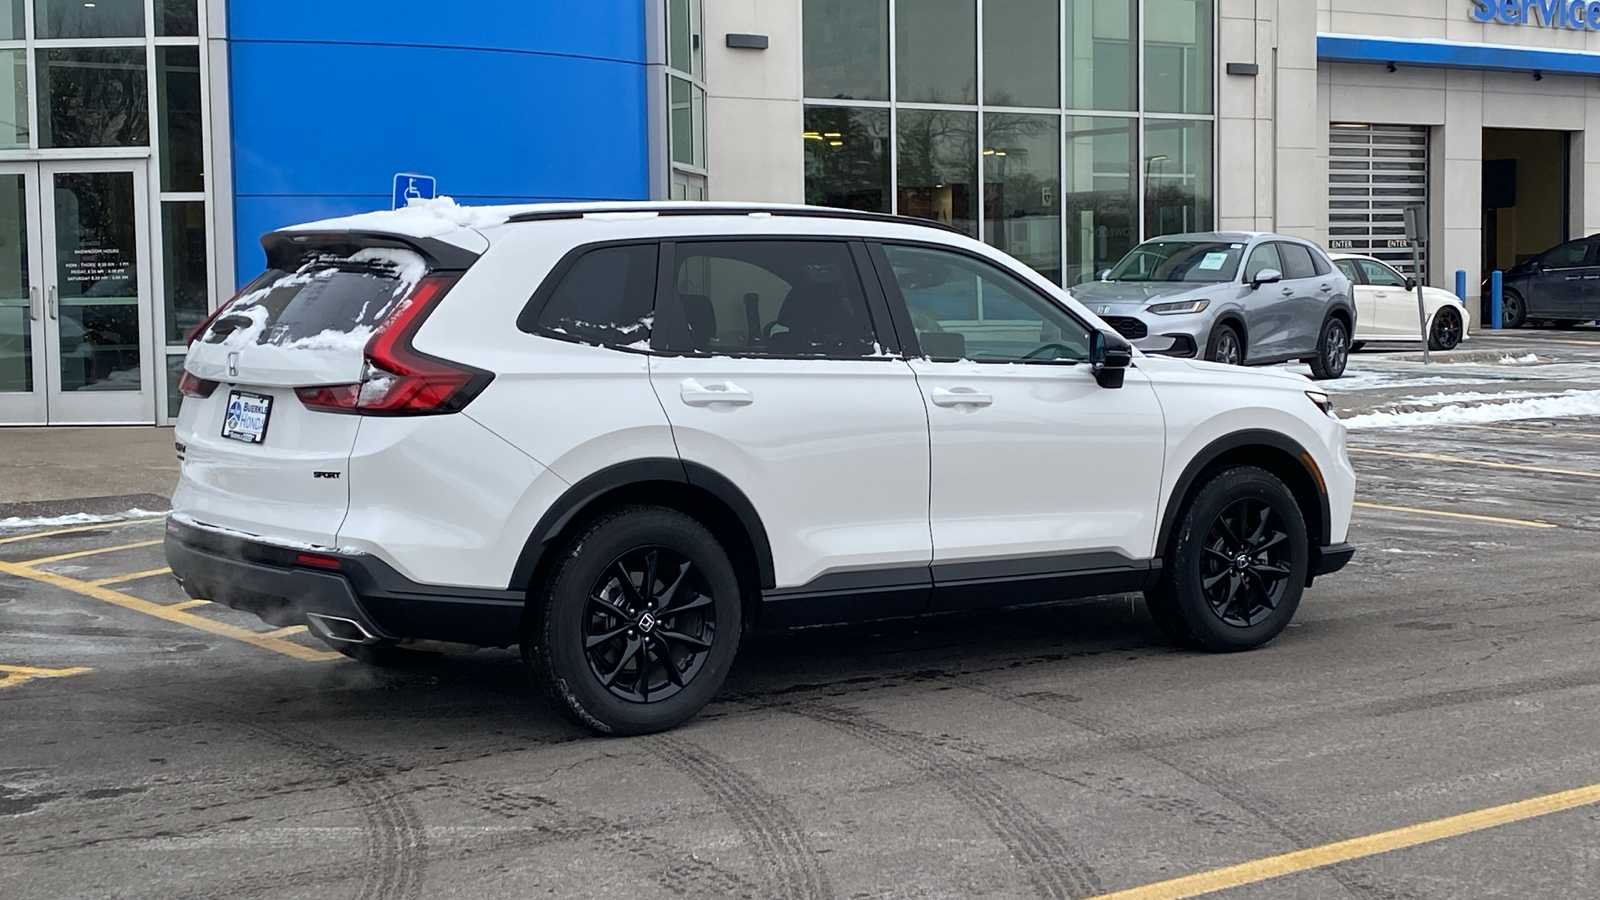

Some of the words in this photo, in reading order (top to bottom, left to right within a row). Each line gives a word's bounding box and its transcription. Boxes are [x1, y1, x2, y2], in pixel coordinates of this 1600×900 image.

[1469, 0, 1600, 30] Service
[1331, 240, 1353, 249] ENTER
[1387, 240, 1408, 248] ENTER
[313, 471, 341, 479] SPORT
